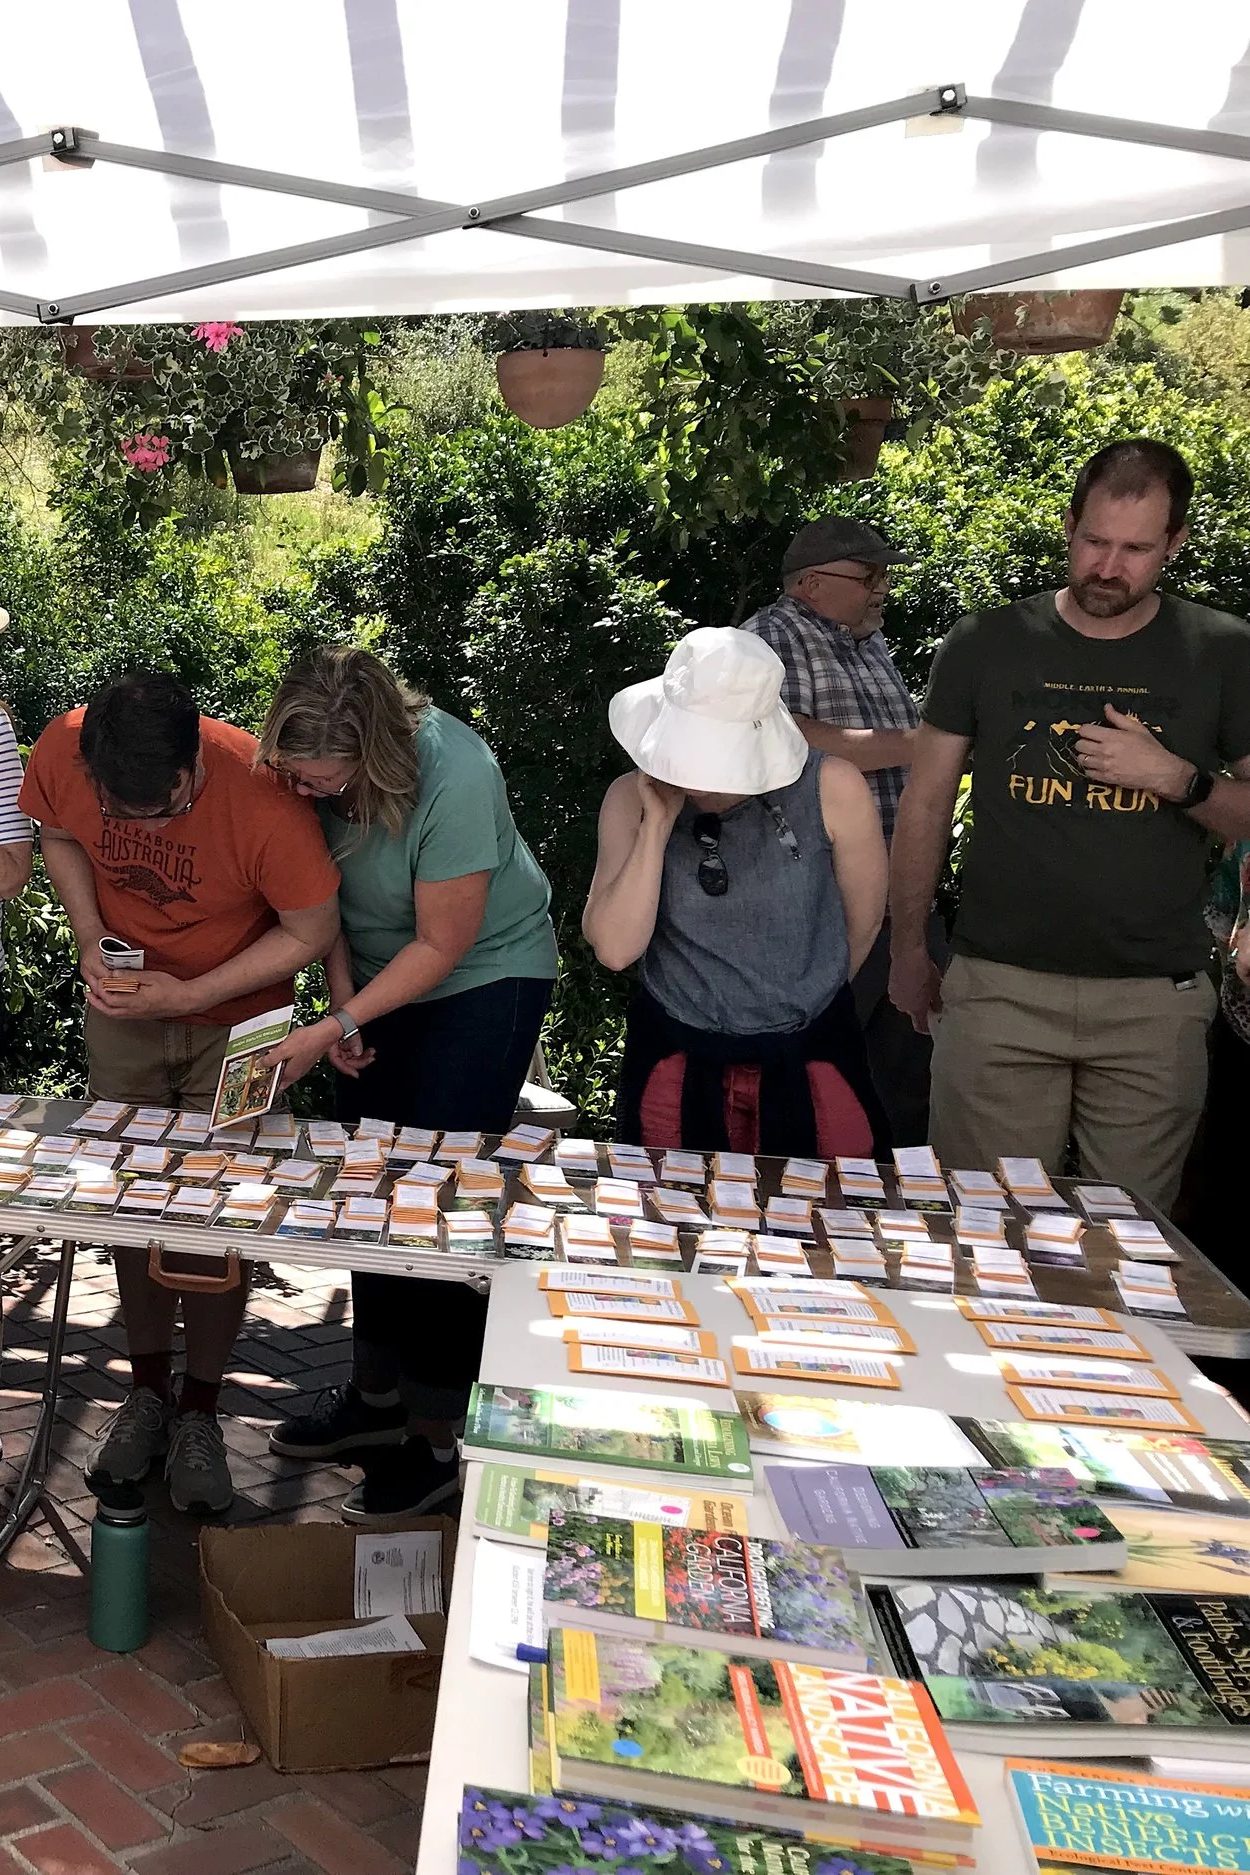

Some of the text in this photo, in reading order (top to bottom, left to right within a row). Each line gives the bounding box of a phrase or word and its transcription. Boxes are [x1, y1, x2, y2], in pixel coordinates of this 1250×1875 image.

[1043, 682, 1075, 690] MIDDLE
[1009, 774, 1159, 813] FUN RUN
[93, 829, 202, 889] AUSTRALIA
[102, 816, 197, 857] WALKABOUT
[686, 1542, 718, 1601] GARDEN
[714, 1536, 752, 1623] CALIFORNIA
[1172, 1616, 1204, 1629] &
[1194, 1600, 1244, 1645] Paths,
[787, 1661, 860, 1807] LANDSCAPE
[821, 1669, 924, 1817] NATIVE
[880, 1678, 961, 1817] CALIFORNIA
[1027, 1773, 1210, 1819] Farming
[1033, 1791, 1178, 1828] Native
[1043, 1828, 1240, 1870] INSECTS
